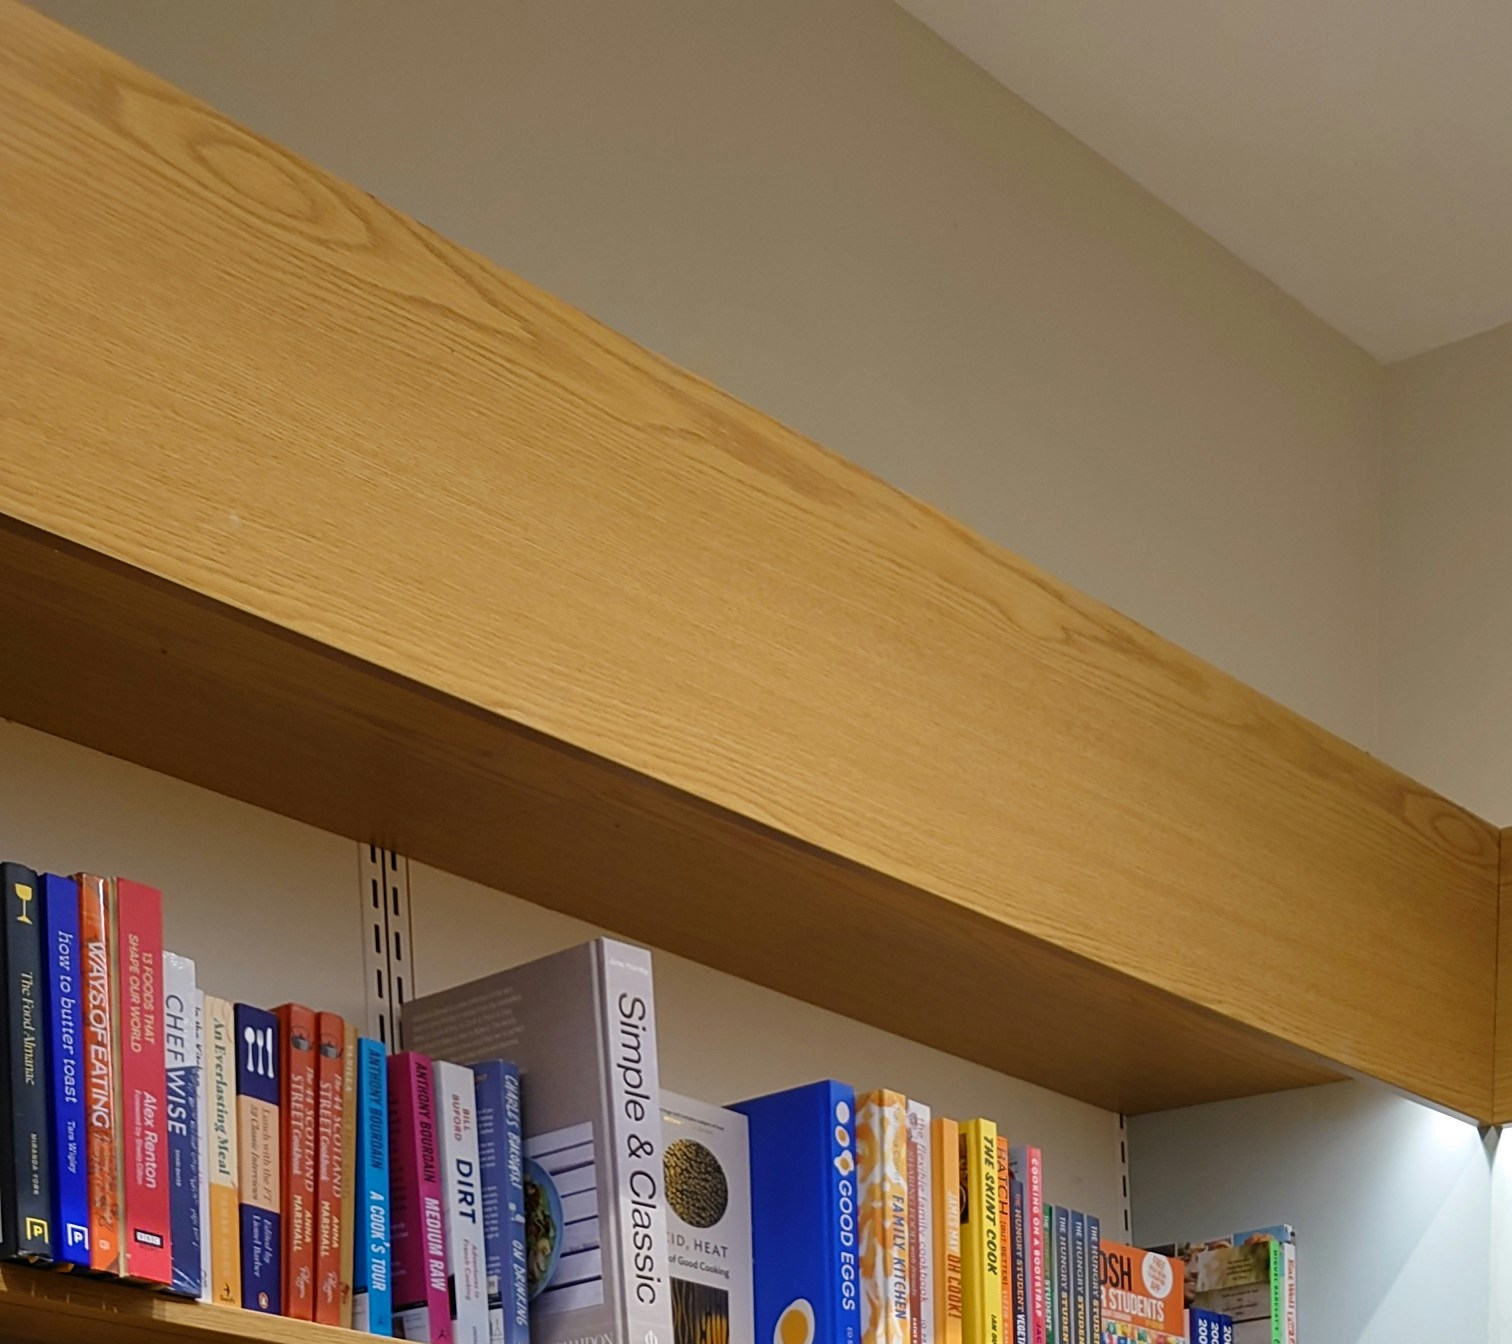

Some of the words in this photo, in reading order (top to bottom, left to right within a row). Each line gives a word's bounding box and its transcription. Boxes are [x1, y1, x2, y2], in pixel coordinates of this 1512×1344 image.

[165, 994, 187, 1137] CHEFWISE
[619, 991, 651, 1117] Simple
[627, 1136, 654, 1158] &
[630, 1171, 656, 1305] Classic
